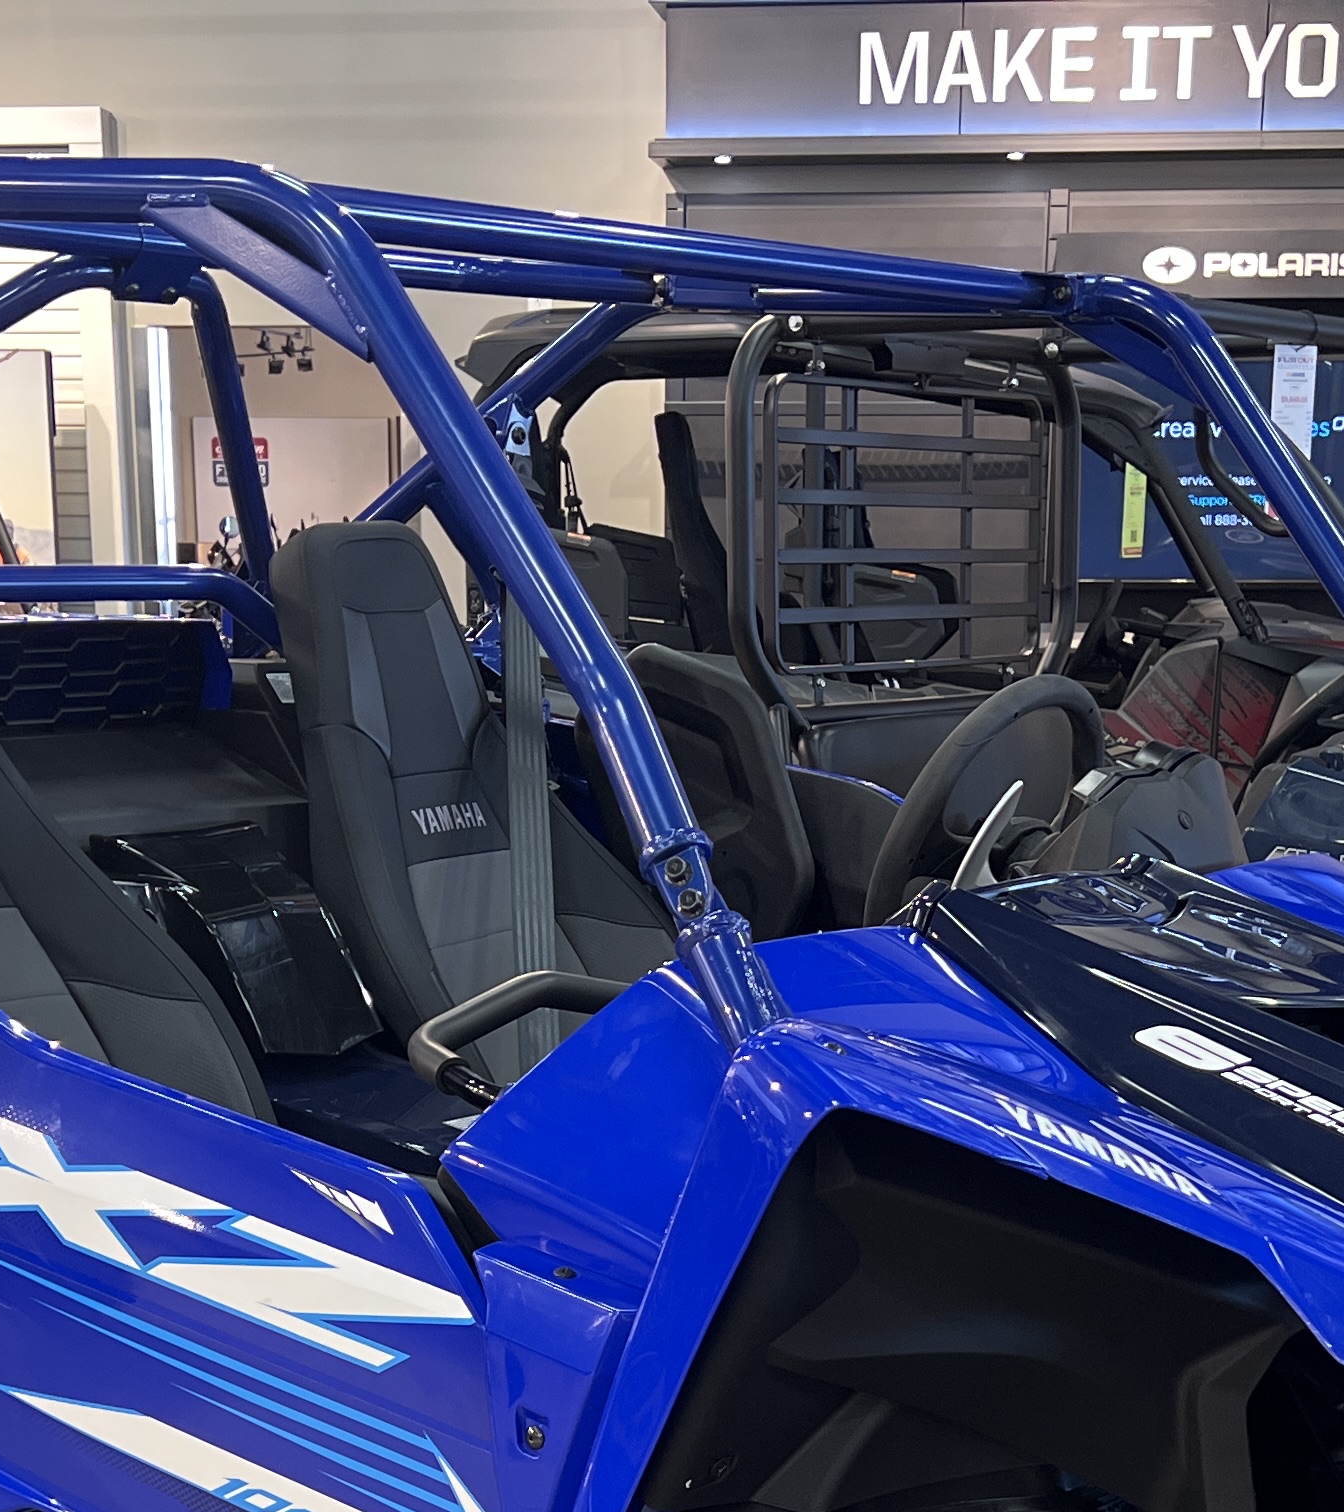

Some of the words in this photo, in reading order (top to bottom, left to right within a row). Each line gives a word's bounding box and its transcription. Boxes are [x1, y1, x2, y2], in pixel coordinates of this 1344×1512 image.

[858, 27, 1098, 105] MAKE
[1119, 25, 1214, 101] IT
[411, 802, 487, 834] YAMAHA
[1134, 1025, 1253, 1071] 6
[995, 1098, 1212, 1204] YAMAHA
